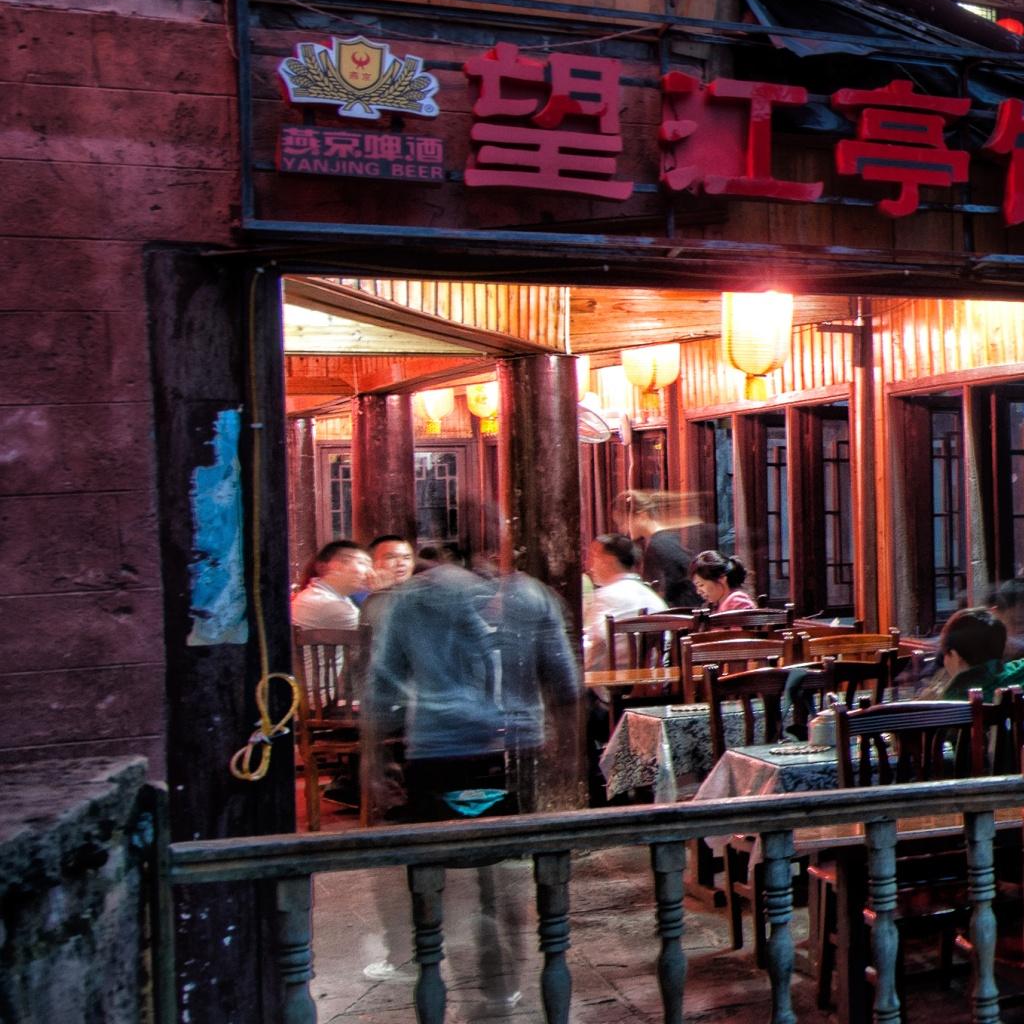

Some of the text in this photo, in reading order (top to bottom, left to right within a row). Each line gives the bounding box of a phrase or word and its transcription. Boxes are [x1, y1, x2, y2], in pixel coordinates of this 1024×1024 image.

[282, 128, 444, 163] 燕京啤酒
[282, 157, 443, 179] YANJING BEER
